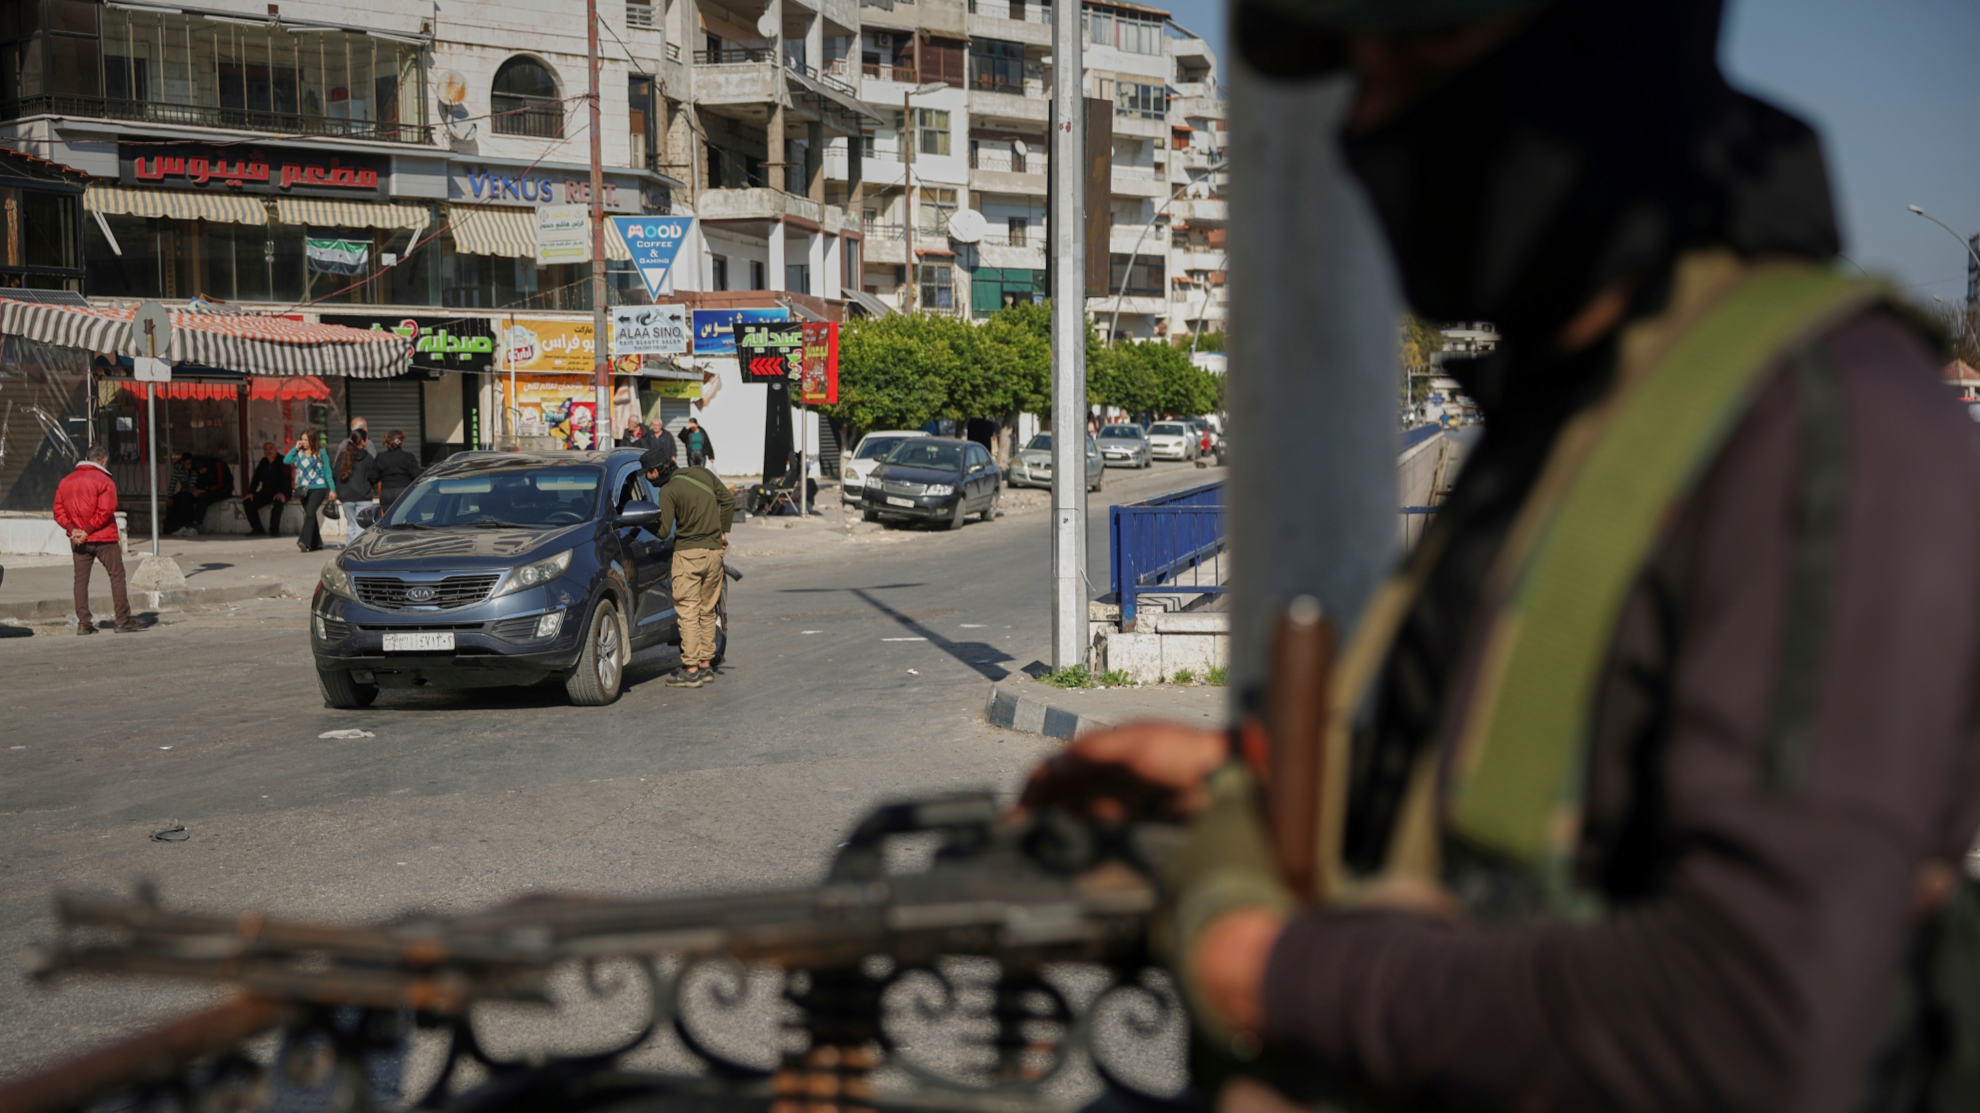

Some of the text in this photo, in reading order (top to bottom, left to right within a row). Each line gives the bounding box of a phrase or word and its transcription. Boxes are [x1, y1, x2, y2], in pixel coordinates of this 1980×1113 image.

[278, 157, 378, 188] مطعم
[465, 167, 553, 201] VENUS
[566, 181, 619, 206] RET.
[627, 222, 682, 239] MOOD
[650, 249, 659, 258] &
[574, 326, 593, 335] ماركت
[619, 326, 681, 340] ALAA SINO
[416, 327, 493, 360] صيدلية
[542, 333, 580, 354] فراس
[411, 589, 430, 598] KIA
